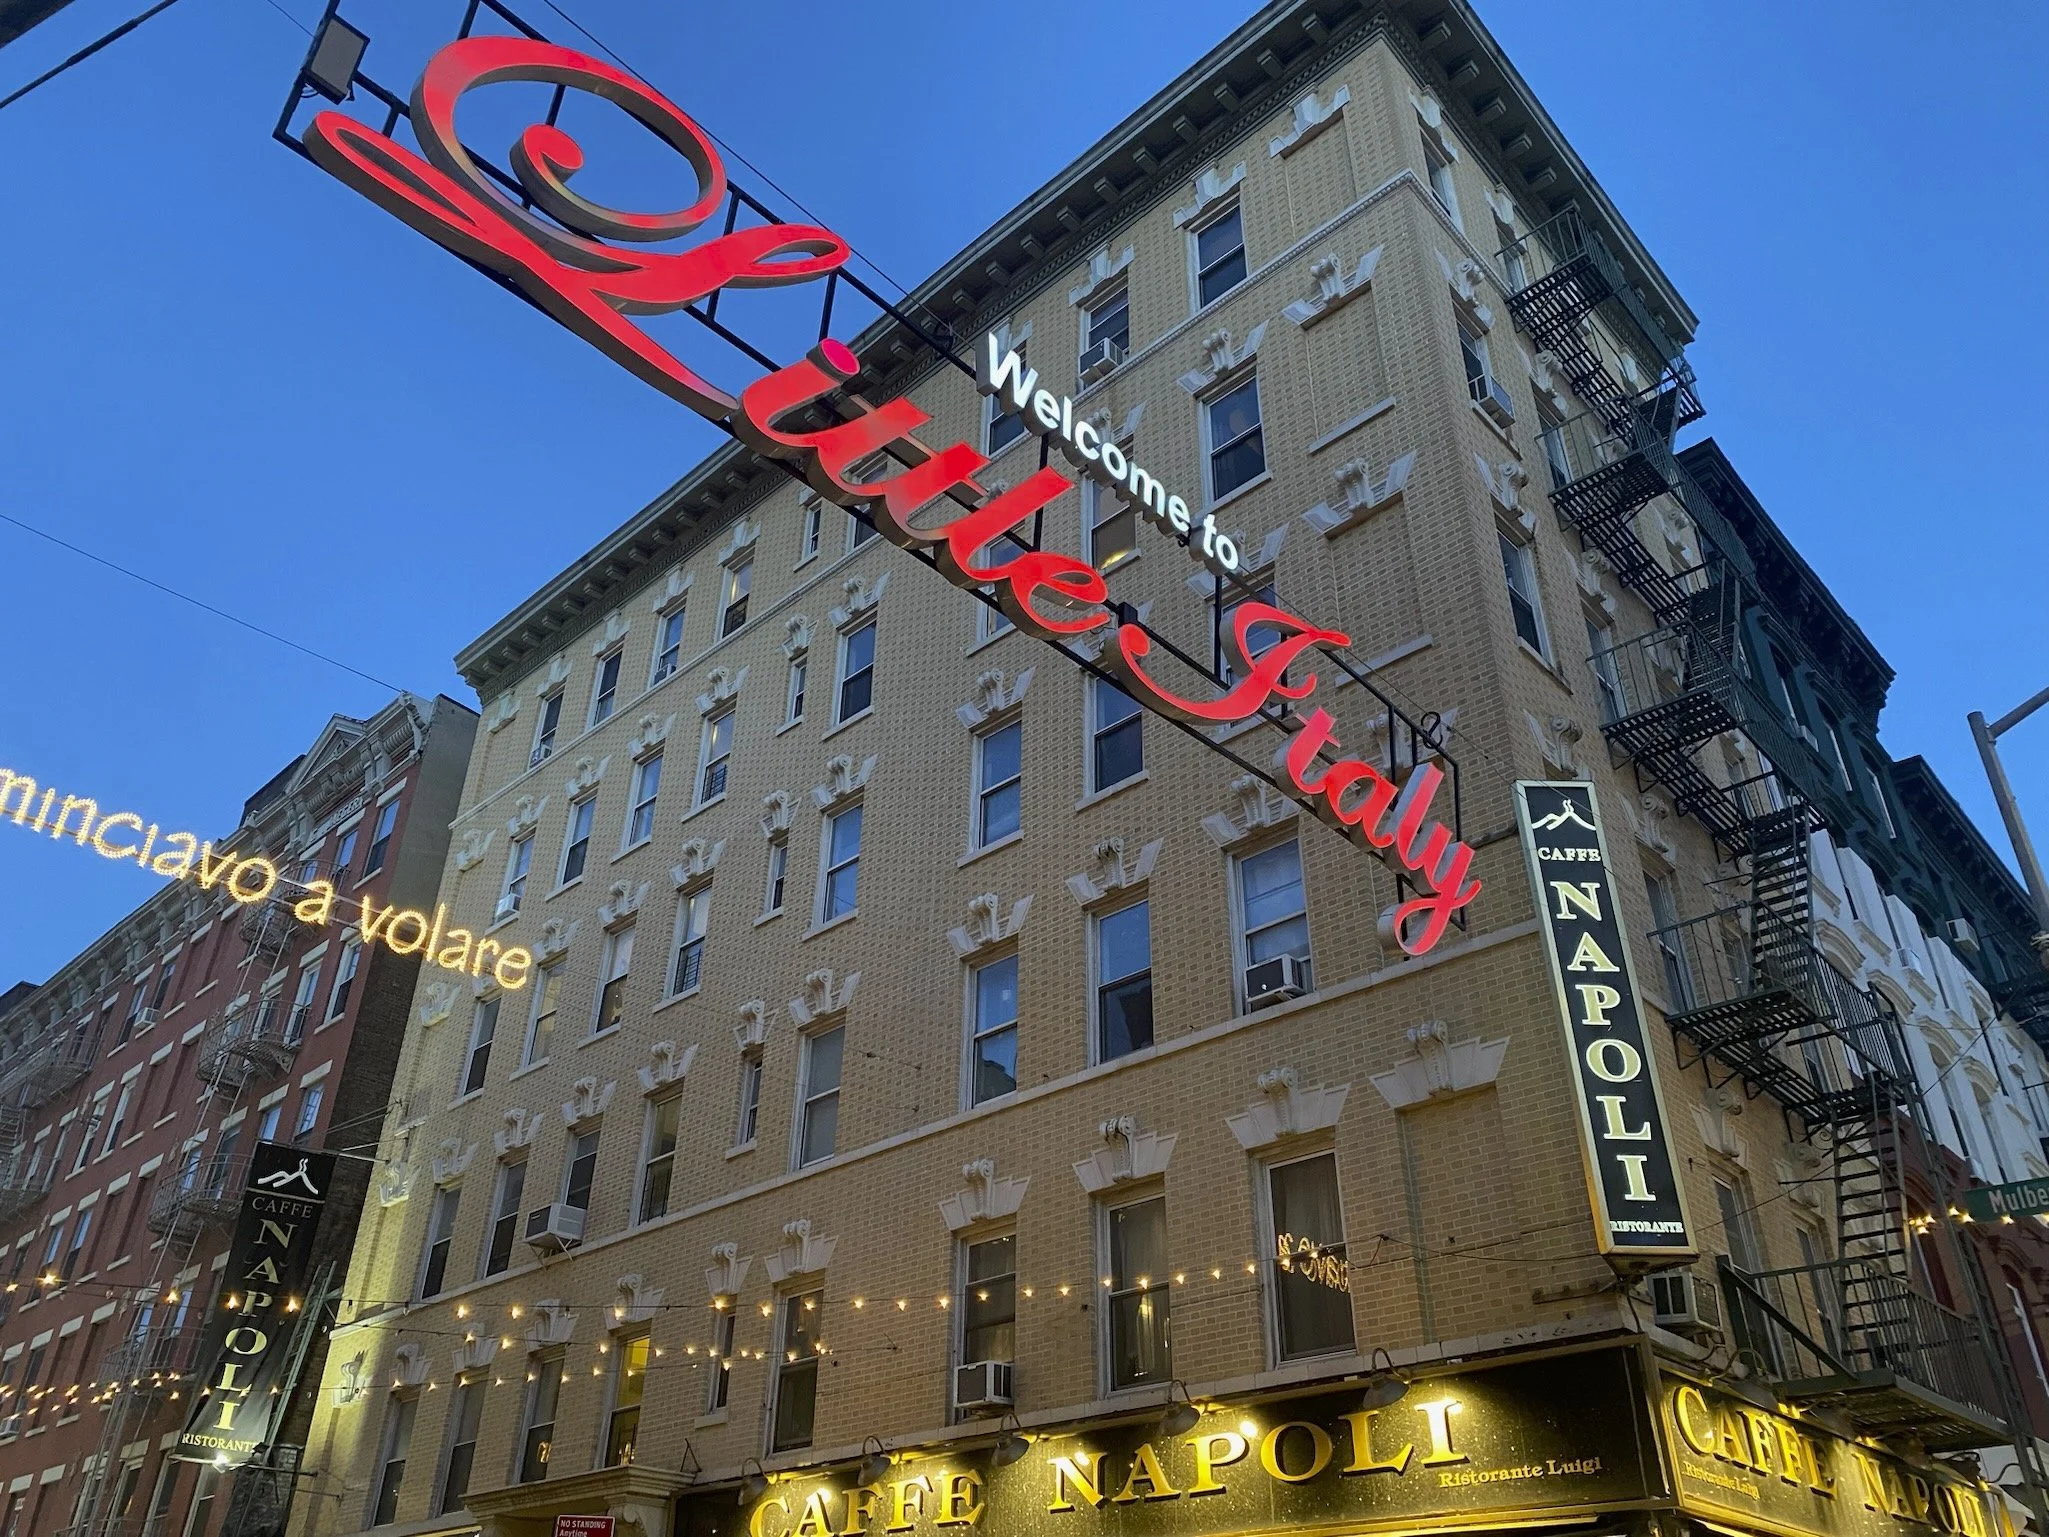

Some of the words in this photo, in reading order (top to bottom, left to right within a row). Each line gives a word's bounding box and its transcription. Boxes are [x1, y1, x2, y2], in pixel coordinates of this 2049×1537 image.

[988, 331, 1191, 533] Welcome
[1203, 513, 1239, 570] to
[303, 35, 1112, 636] Little
[1105, 601, 1482, 956] Italy
[1538, 846, 1601, 862] CAFFE
[295, 880, 335, 926] a
[360, 894, 532, 990] volare
[1550, 881, 1657, 1202] NAPOLI
[251, 1197, 313, 1219] CAFFE
[1610, 1220, 1684, 1233] RISTORANTE
[1987, 1184, 2049, 1214] Mulbe
[212, 1218, 299, 1432] NAPOLI
[750, 1470, 984, 1537] CAFFE
[1047, 1399, 1470, 1513] NAPOLI
[1439, 1464, 1543, 1488] Ristorante
[1546, 1456, 1603, 1475] Luigi
[1674, 1386, 1838, 1499] CAFFE
[1851, 1452, 1987, 1537] NAPOLI
[560, 1520, 571, 1528] NO
[572, 1520, 606, 1529] STANDING
[560, 1529, 588, 1537] Anytime
